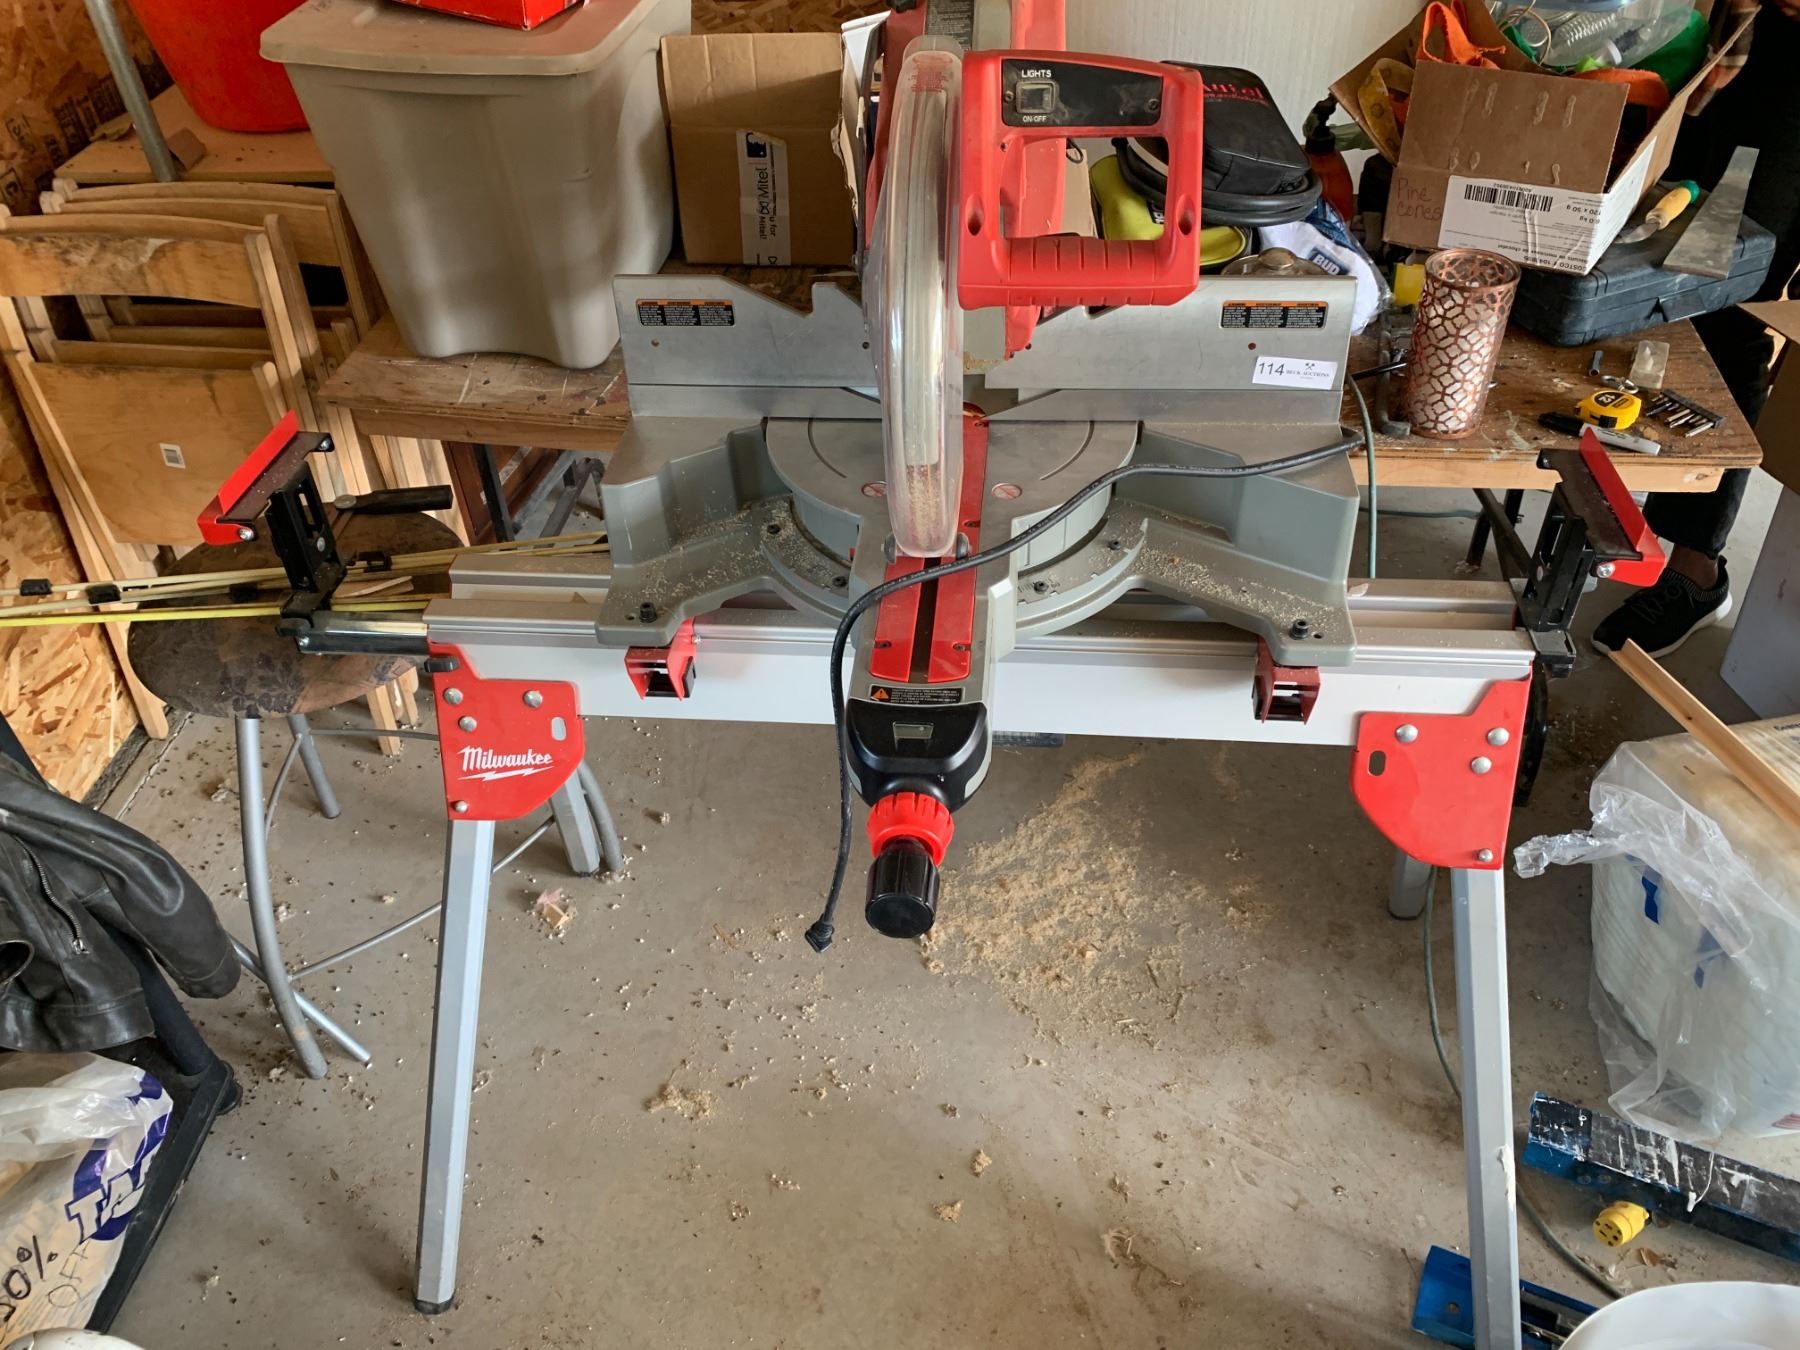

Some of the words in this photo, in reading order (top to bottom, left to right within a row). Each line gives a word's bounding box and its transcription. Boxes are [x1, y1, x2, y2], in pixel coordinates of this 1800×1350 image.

[1021, 69, 1052, 78] LIGHTS
[756, 167, 769, 199] Mitel
[1397, 178, 1432, 203] Pine
[1312, 254, 1340, 276] BUD
[1259, 362, 1285, 376] 114
[457, 746, 554, 772] Milwaukee
